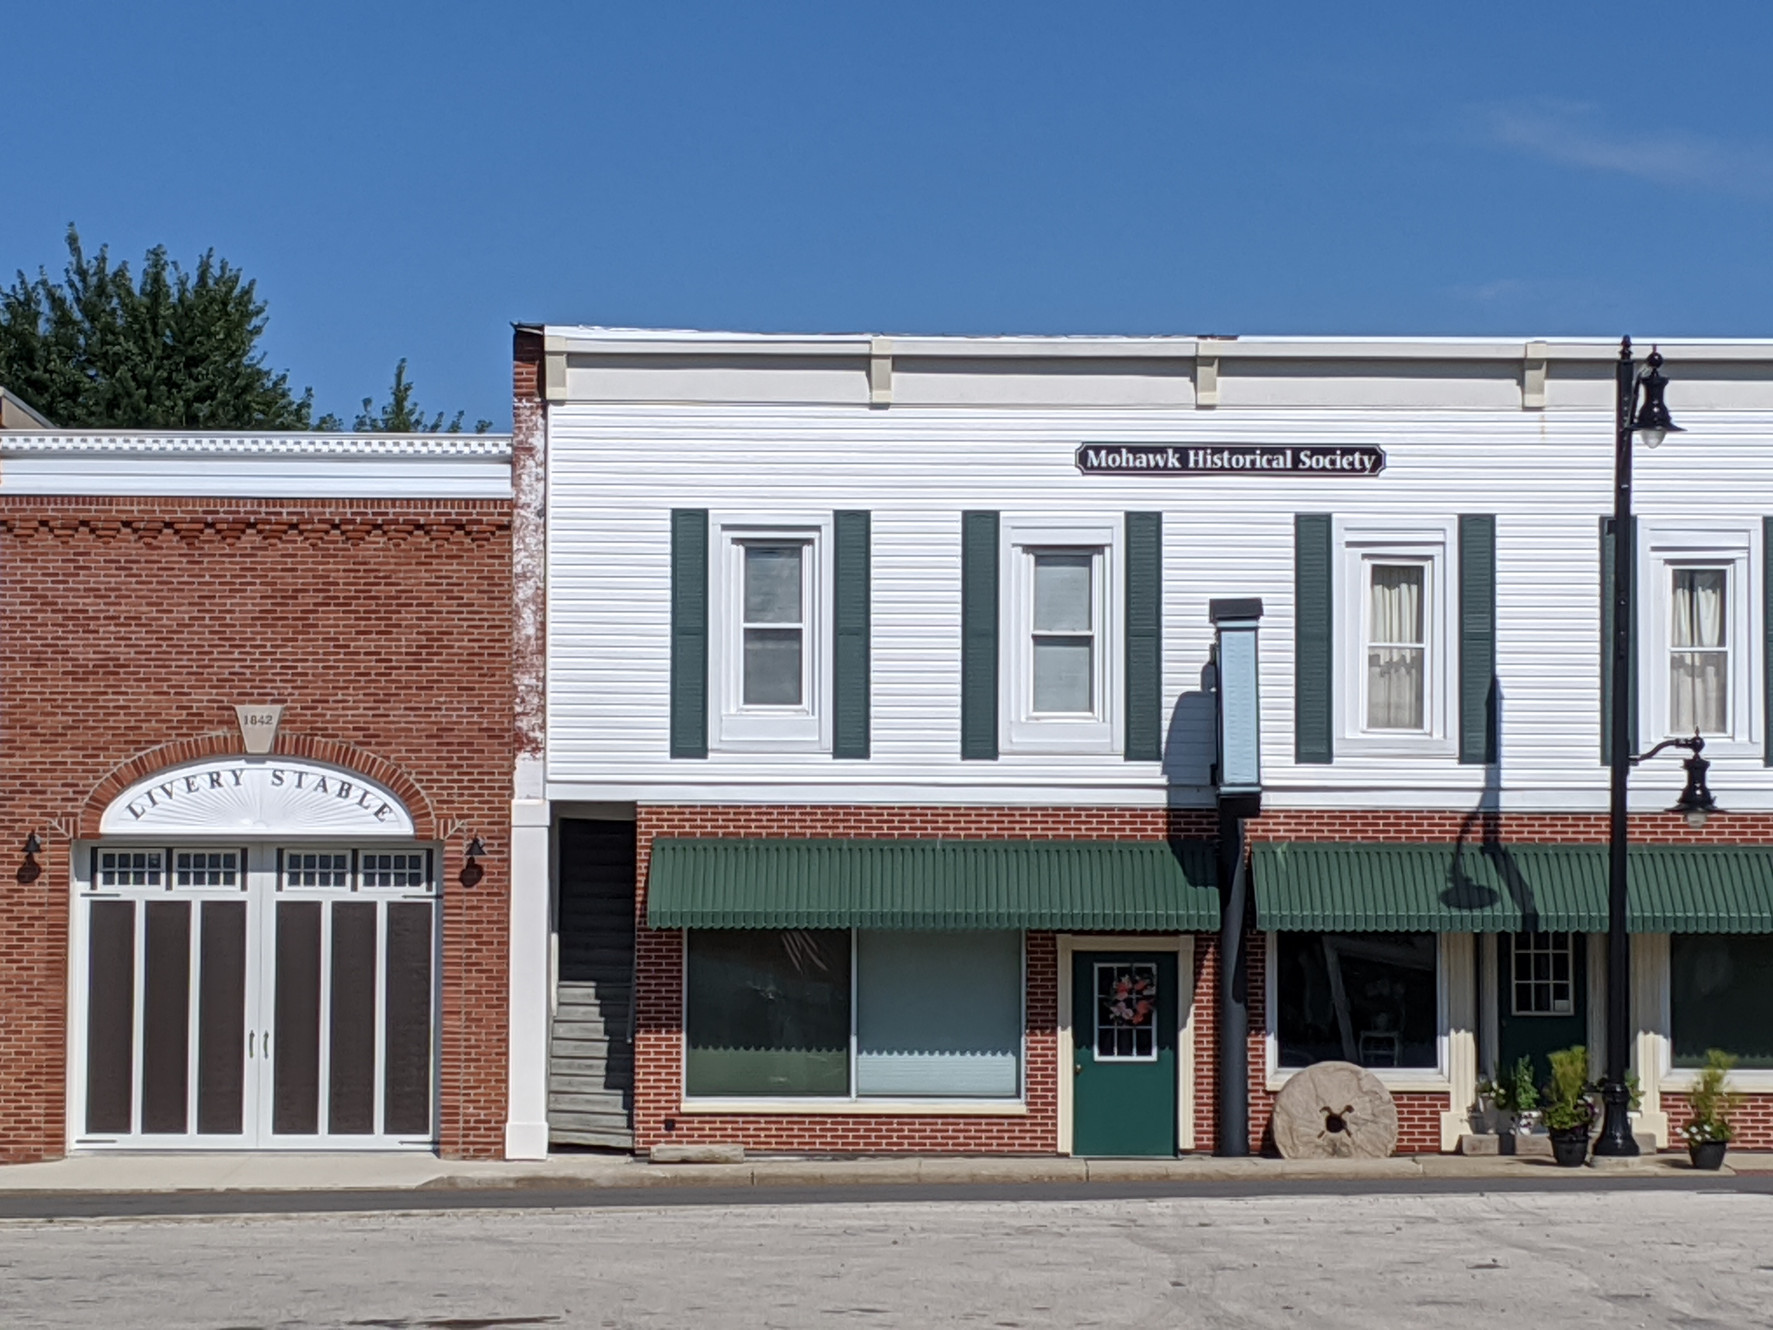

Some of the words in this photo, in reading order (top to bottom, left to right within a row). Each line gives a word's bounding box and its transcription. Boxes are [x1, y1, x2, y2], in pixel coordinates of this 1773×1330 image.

[1087, 447, 1181, 470] Mohawk
[1188, 448, 1292, 470] Historical
[1298, 448, 1376, 474] Society
[243, 714, 273, 726] 1842
[125, 769, 246, 821] LIVERY
[270, 769, 393, 823] STABLE
